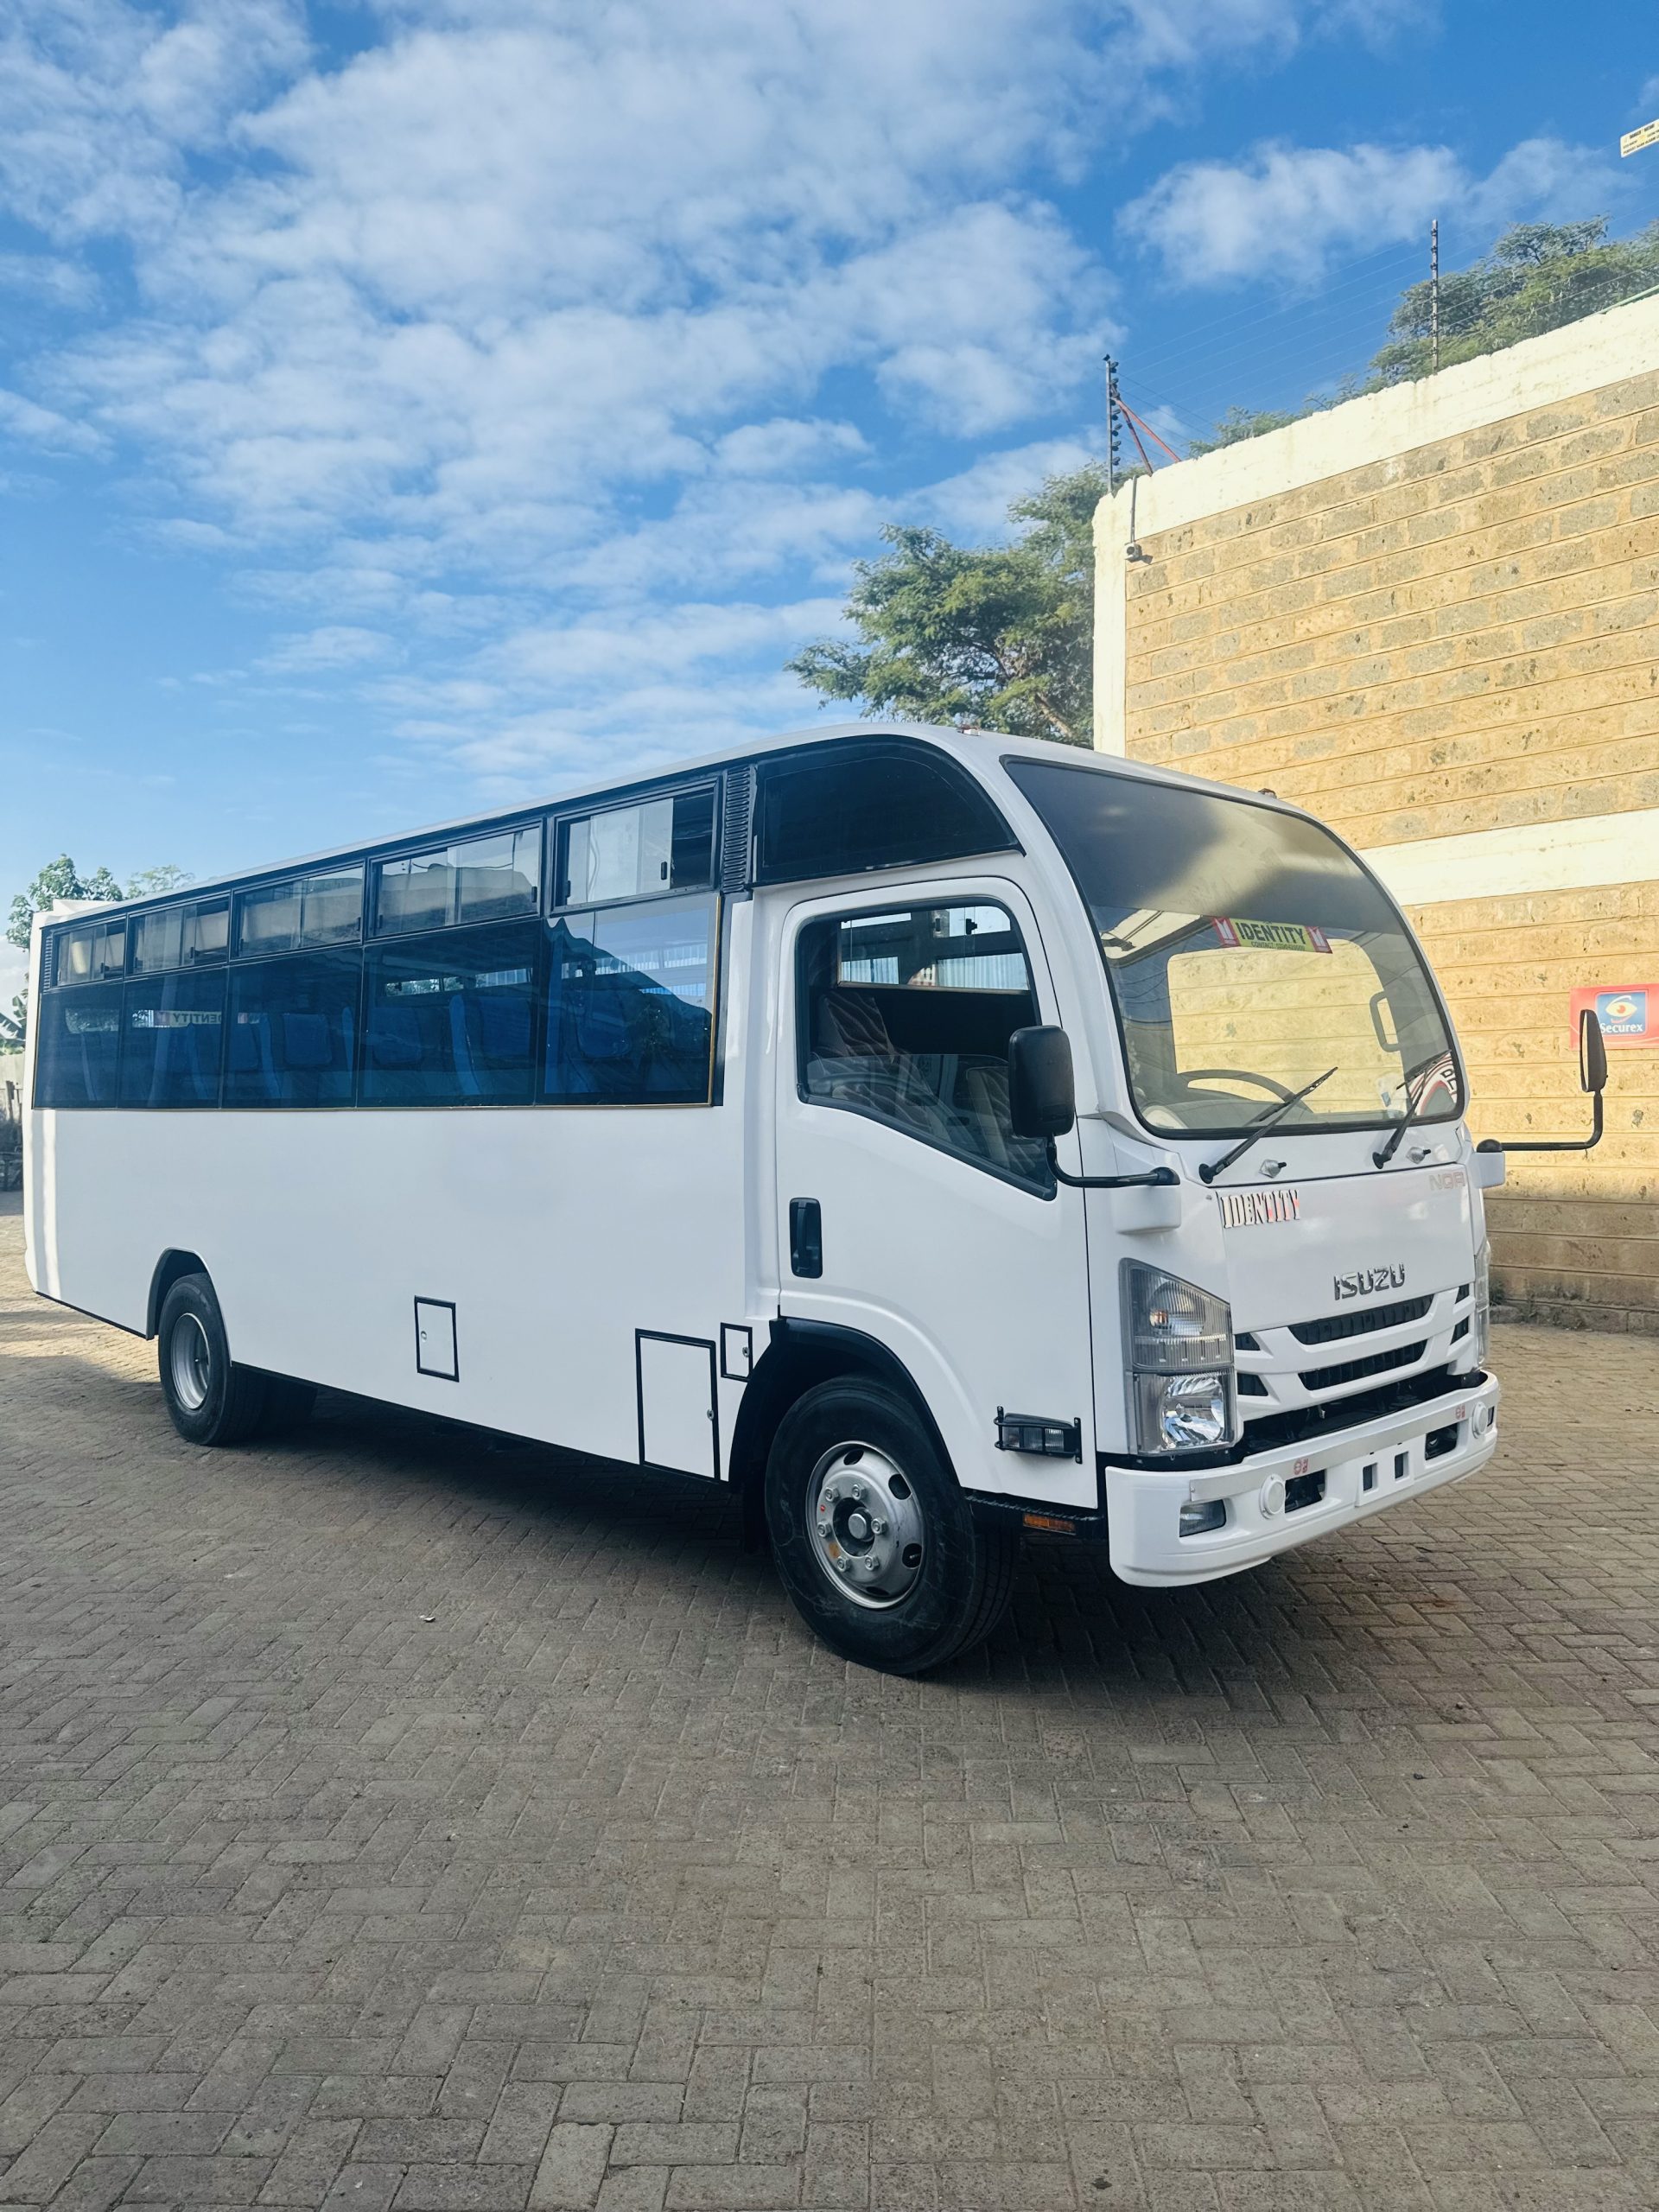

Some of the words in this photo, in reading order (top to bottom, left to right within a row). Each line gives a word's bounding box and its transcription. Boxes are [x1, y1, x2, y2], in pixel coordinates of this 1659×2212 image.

[1236, 922, 1306, 944] IDENTITY
[1599, 1023, 1643, 1033] Securex
[1220, 1189, 1300, 1229] IDENTITY
[1333, 1262, 1405, 1300] ISUZU
